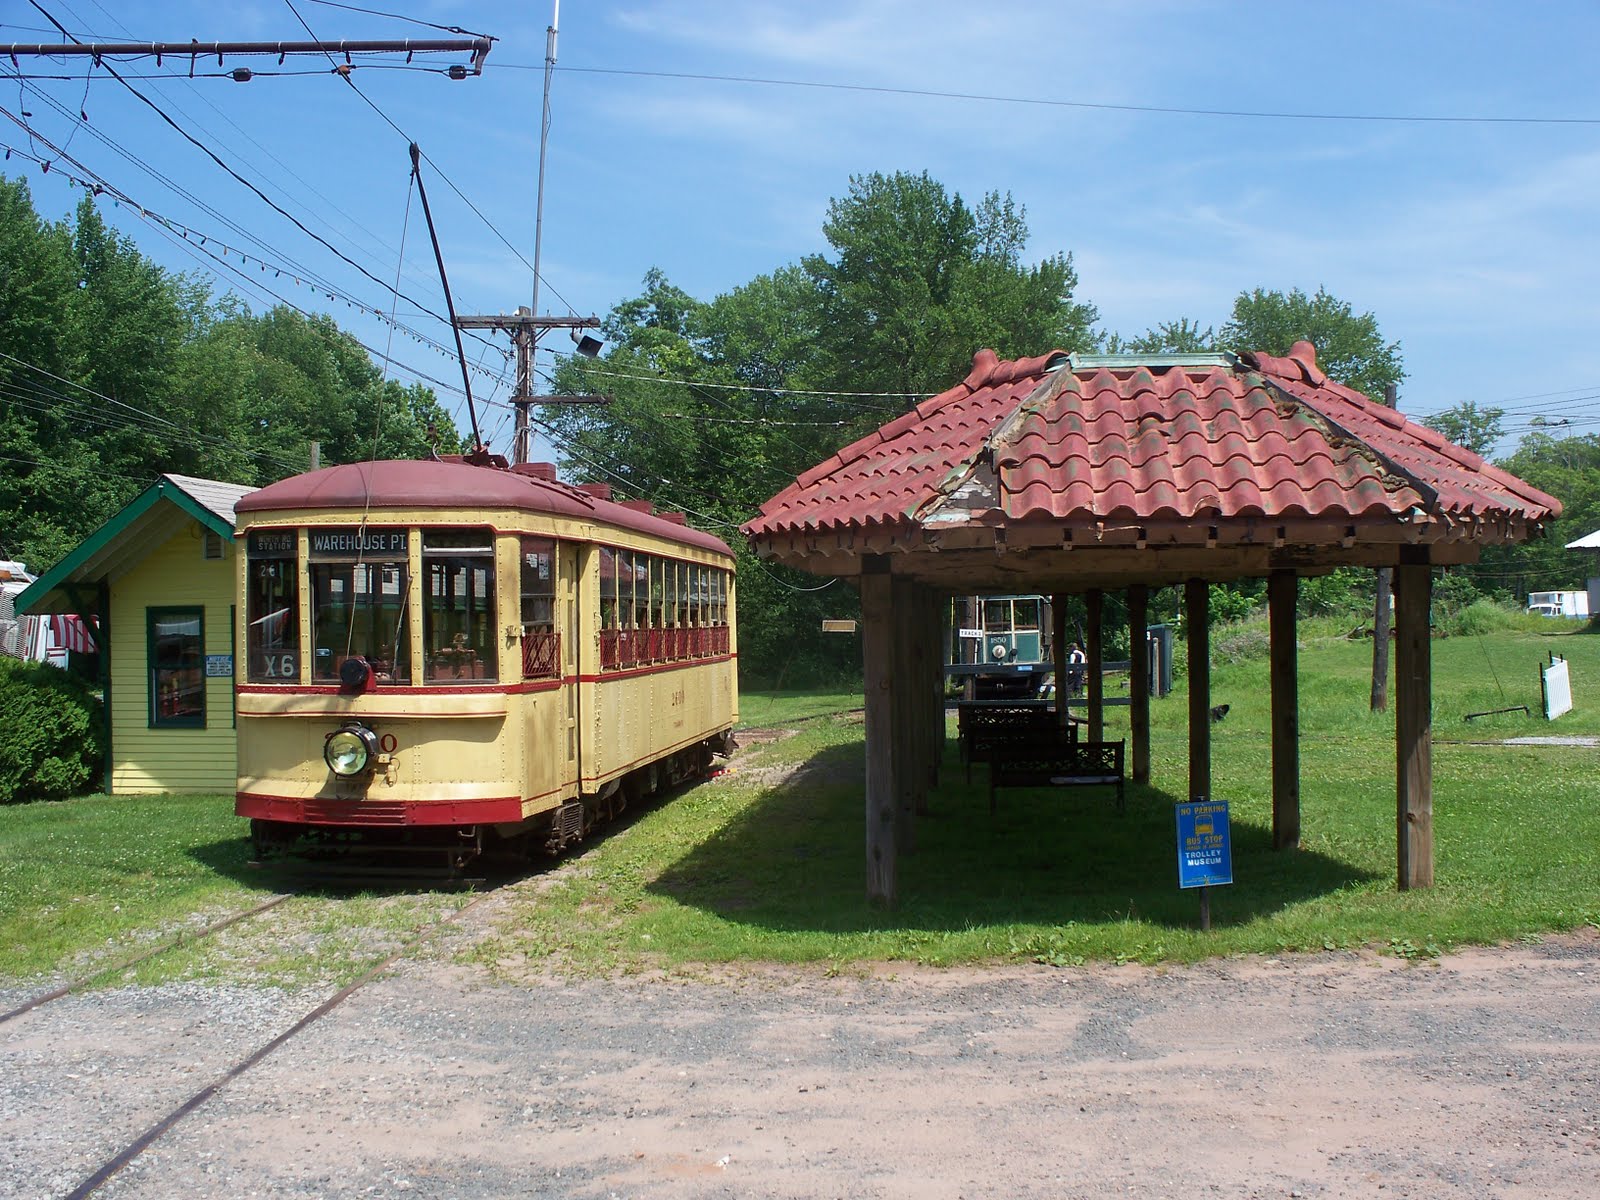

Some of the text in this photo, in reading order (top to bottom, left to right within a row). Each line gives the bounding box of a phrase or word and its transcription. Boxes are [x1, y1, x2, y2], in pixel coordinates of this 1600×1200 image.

[314, 534, 407, 551] WAREHOUSE PT.
[264, 654, 295, 677] X6
[1194, 805, 1225, 814] PARKING
[1186, 835, 1223, 845] BUS STOP
[1185, 850, 1221, 858] TROLLEY
[1188, 858, 1221, 866] MUSEUM
